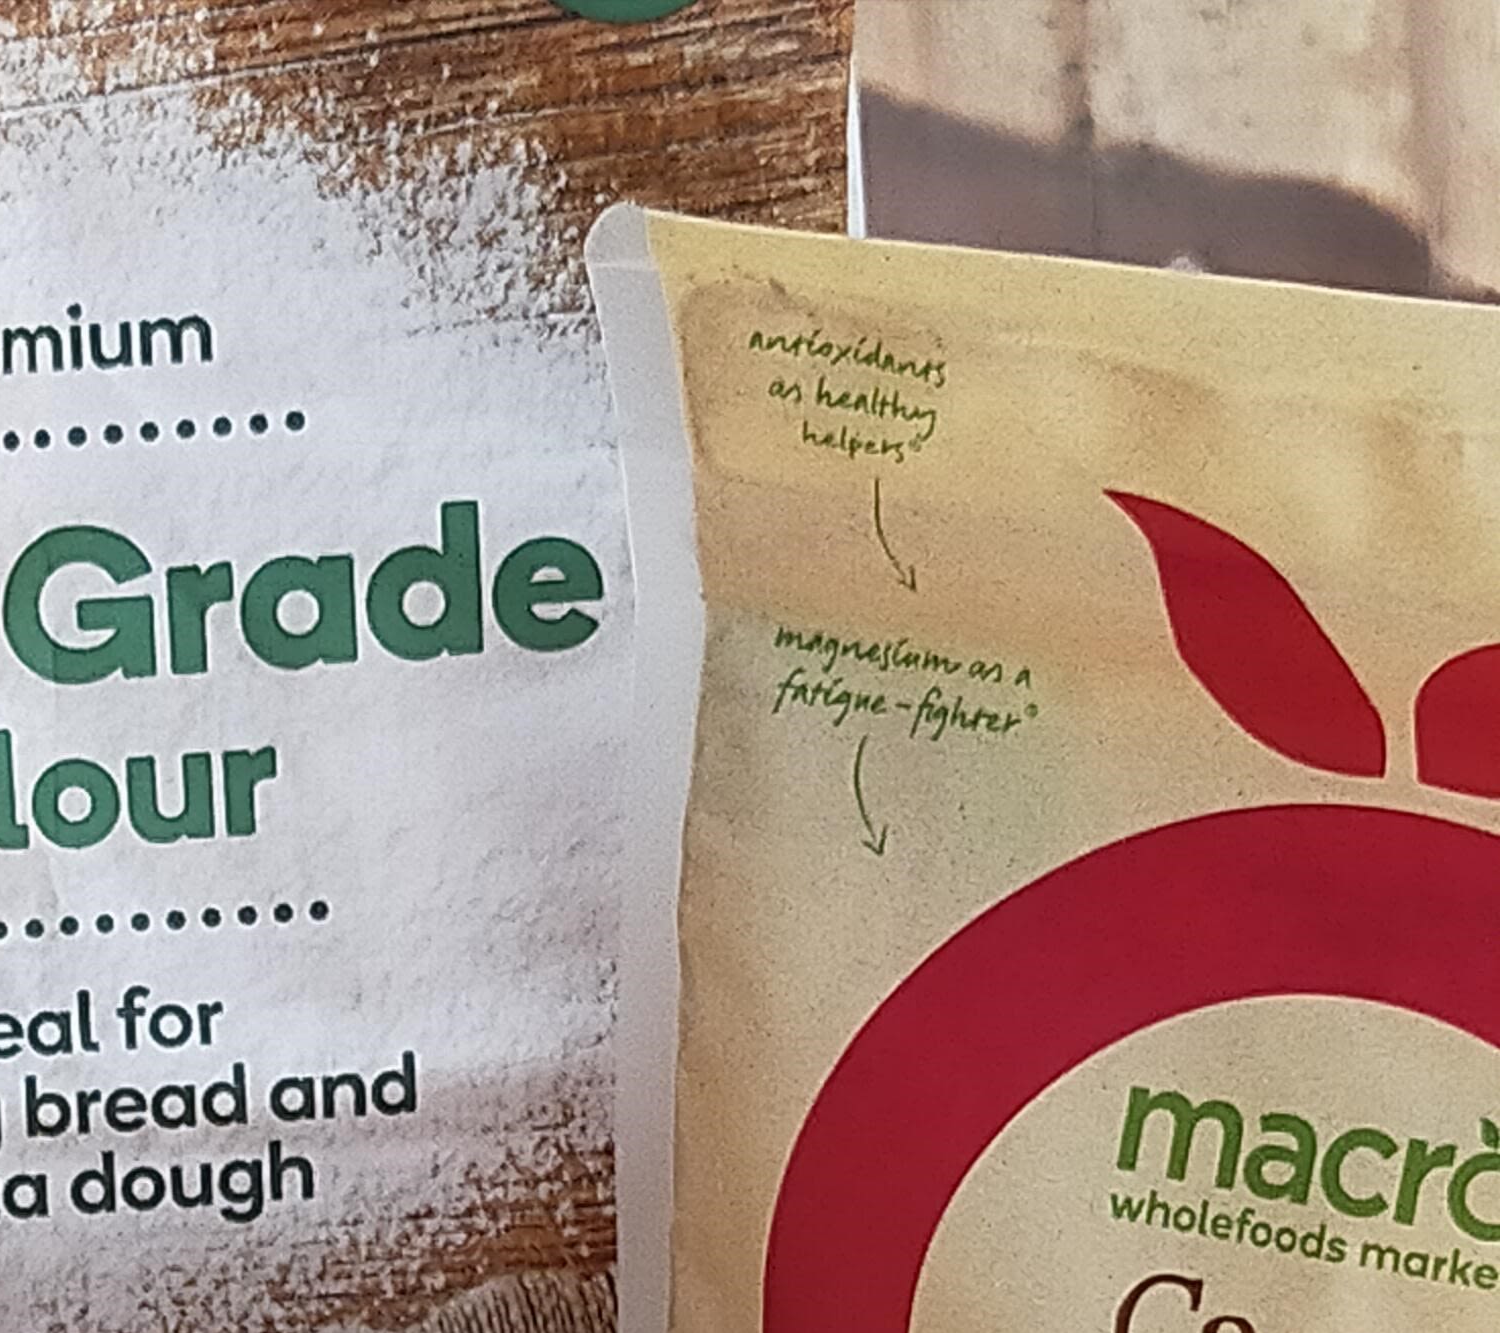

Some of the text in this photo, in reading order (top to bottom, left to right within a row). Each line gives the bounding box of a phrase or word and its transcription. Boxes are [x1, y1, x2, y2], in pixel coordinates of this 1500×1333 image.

[749, 327, 946, 389] antioxidants
[768, 375, 937, 442] as healthy
[1, 499, 605, 685] Grade
[773, 626, 1032, 690] magnesium as a
[116, 984, 224, 1049] for
[23, 1062, 249, 1139] bread
[268, 1050, 419, 1118] and
[69, 1141, 316, 1225] dough
[1109, 1189, 1499, 1290] wholefoods marke
